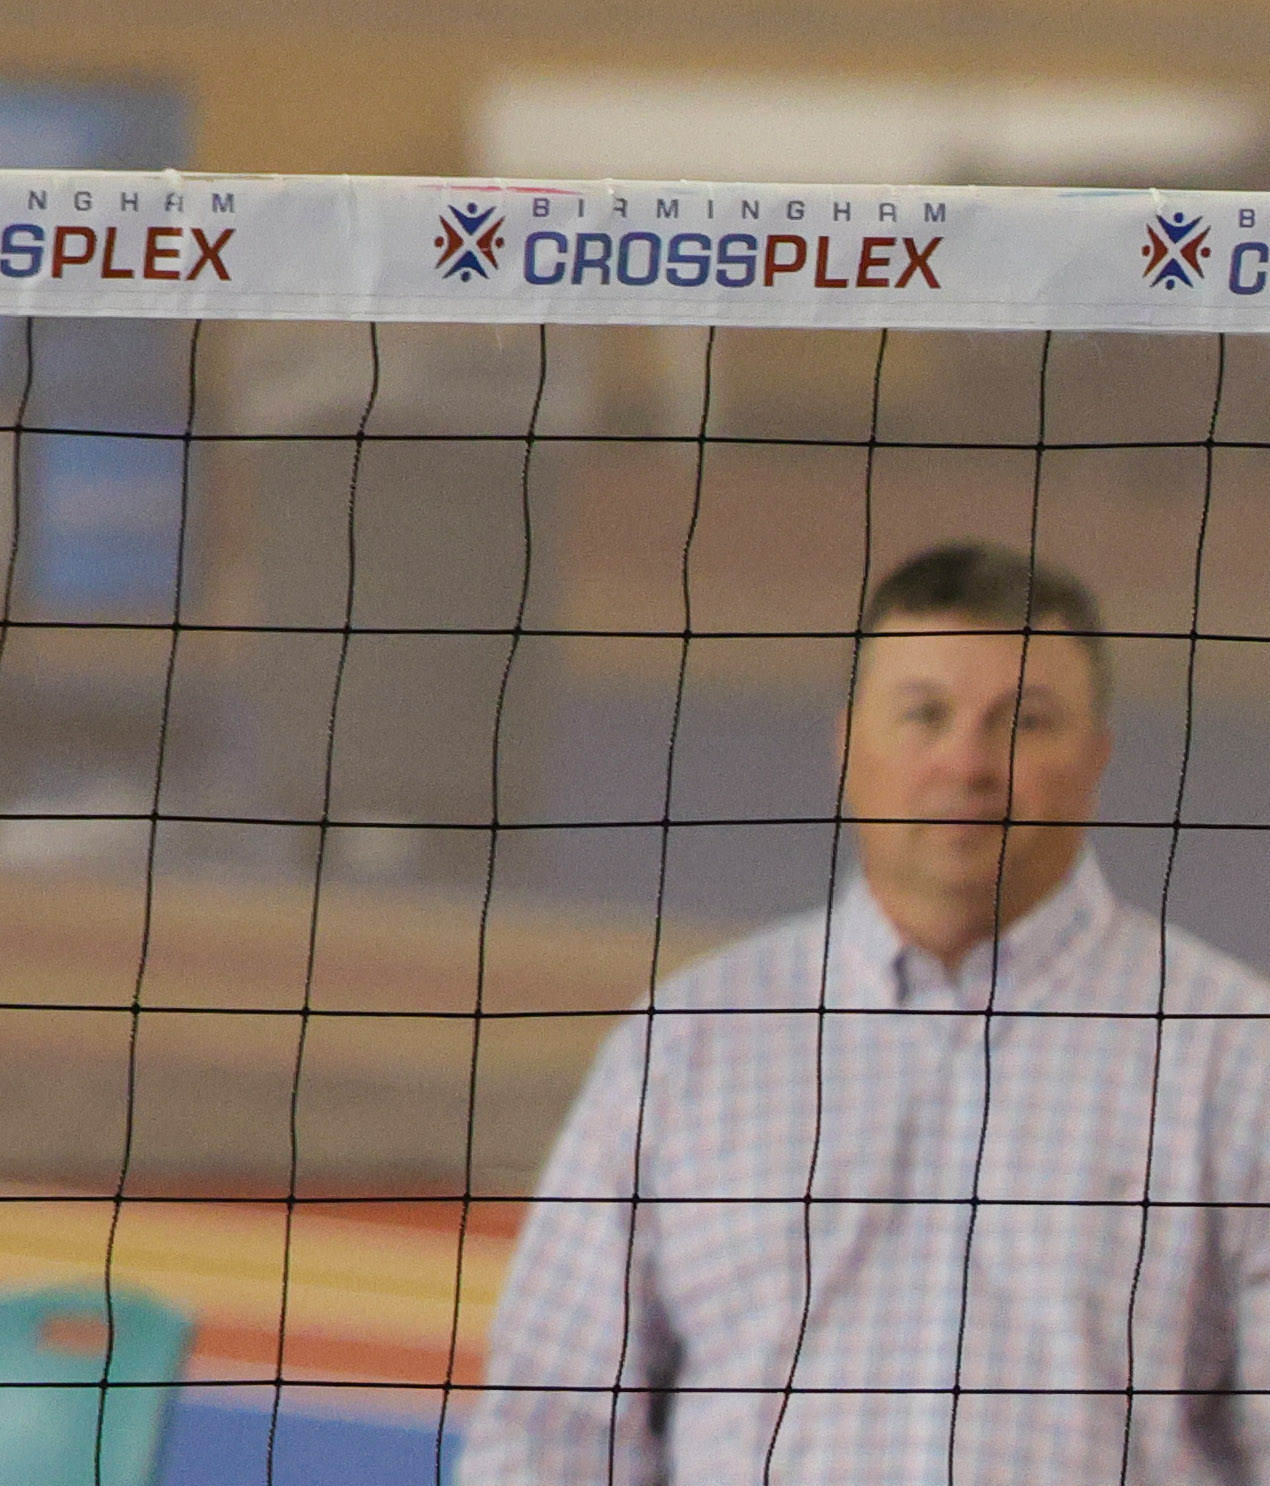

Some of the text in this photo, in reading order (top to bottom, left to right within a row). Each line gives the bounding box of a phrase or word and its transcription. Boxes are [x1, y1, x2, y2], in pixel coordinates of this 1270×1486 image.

[532, 197, 947, 222] BIRMINGHAM
[0, 223, 236, 281] SPLEX
[523, 230, 944, 289] CROSSPLEX
